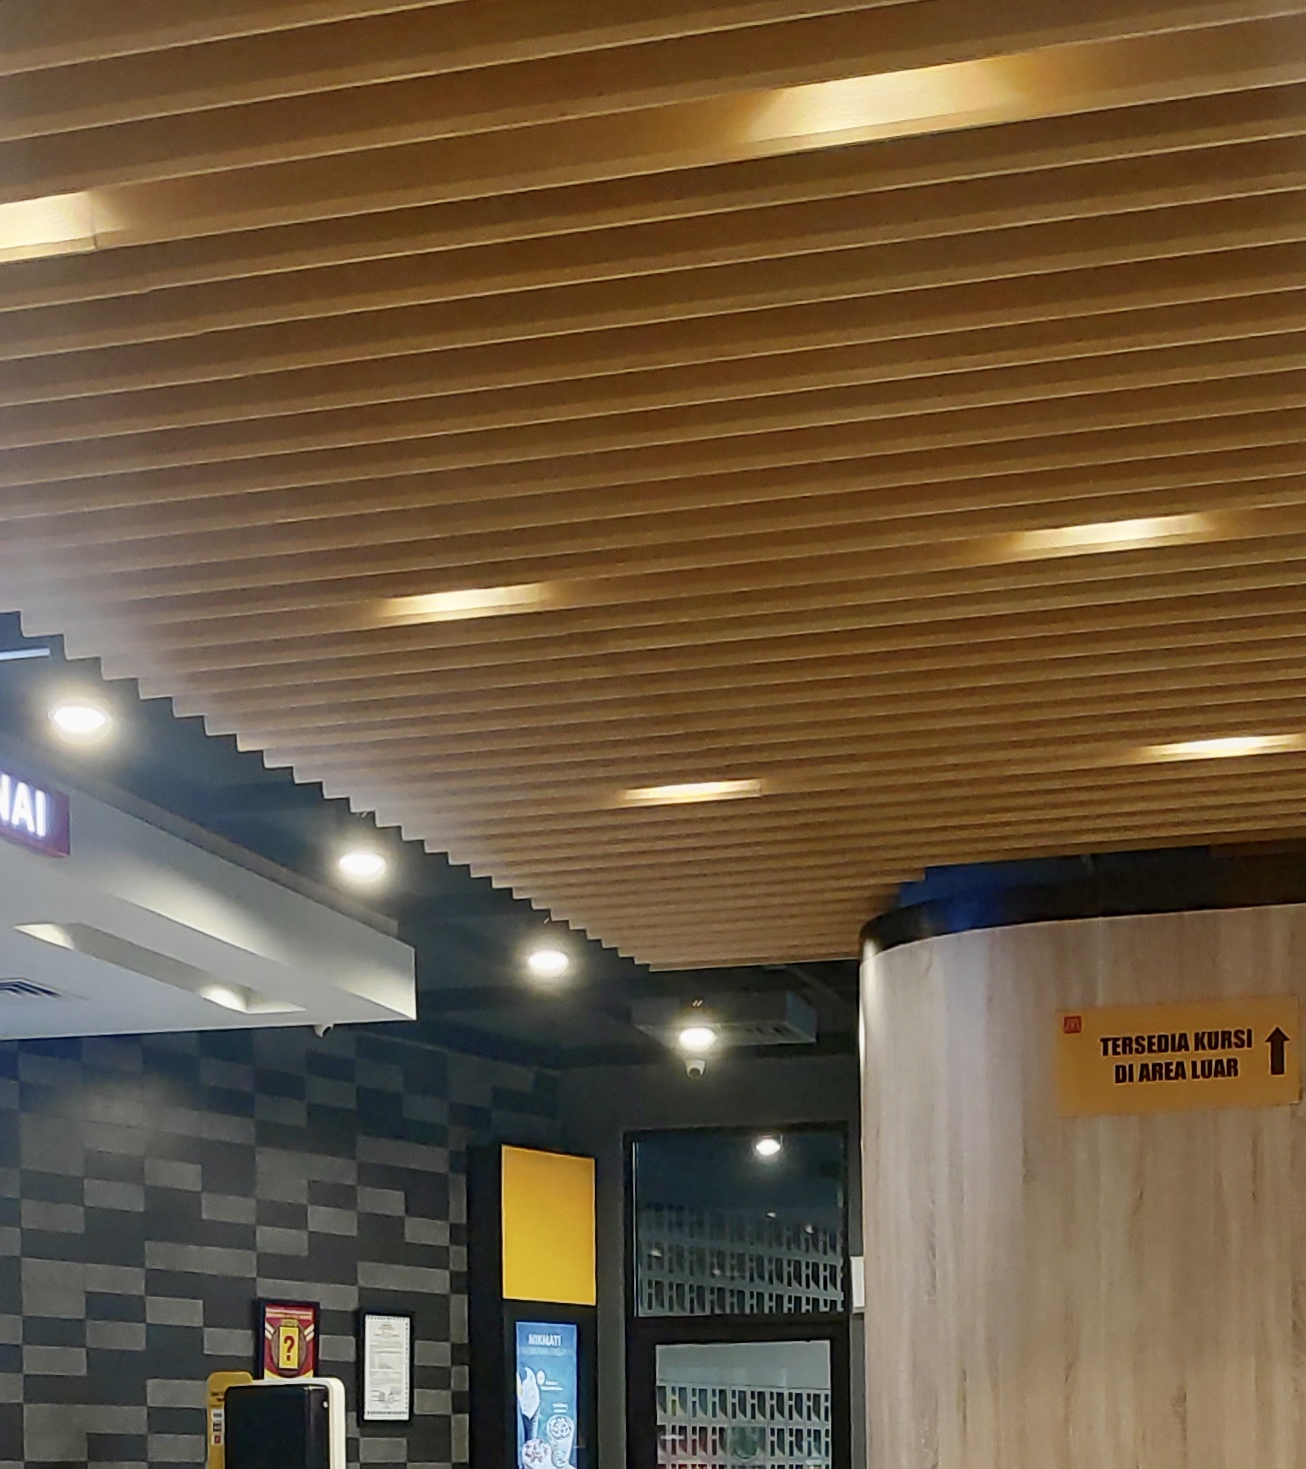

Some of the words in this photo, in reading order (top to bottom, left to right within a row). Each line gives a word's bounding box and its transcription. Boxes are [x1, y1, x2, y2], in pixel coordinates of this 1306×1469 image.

[1099, 1031, 1190, 1057] TERSEDIA
[1193, 1028, 1253, 1052] KURSI
[1114, 1063, 1134, 1084] DI
[1138, 1059, 1187, 1083] AREA
[1191, 1057, 1238, 1080] LUAR
[528, 1333, 562, 1347] NIKMATI
